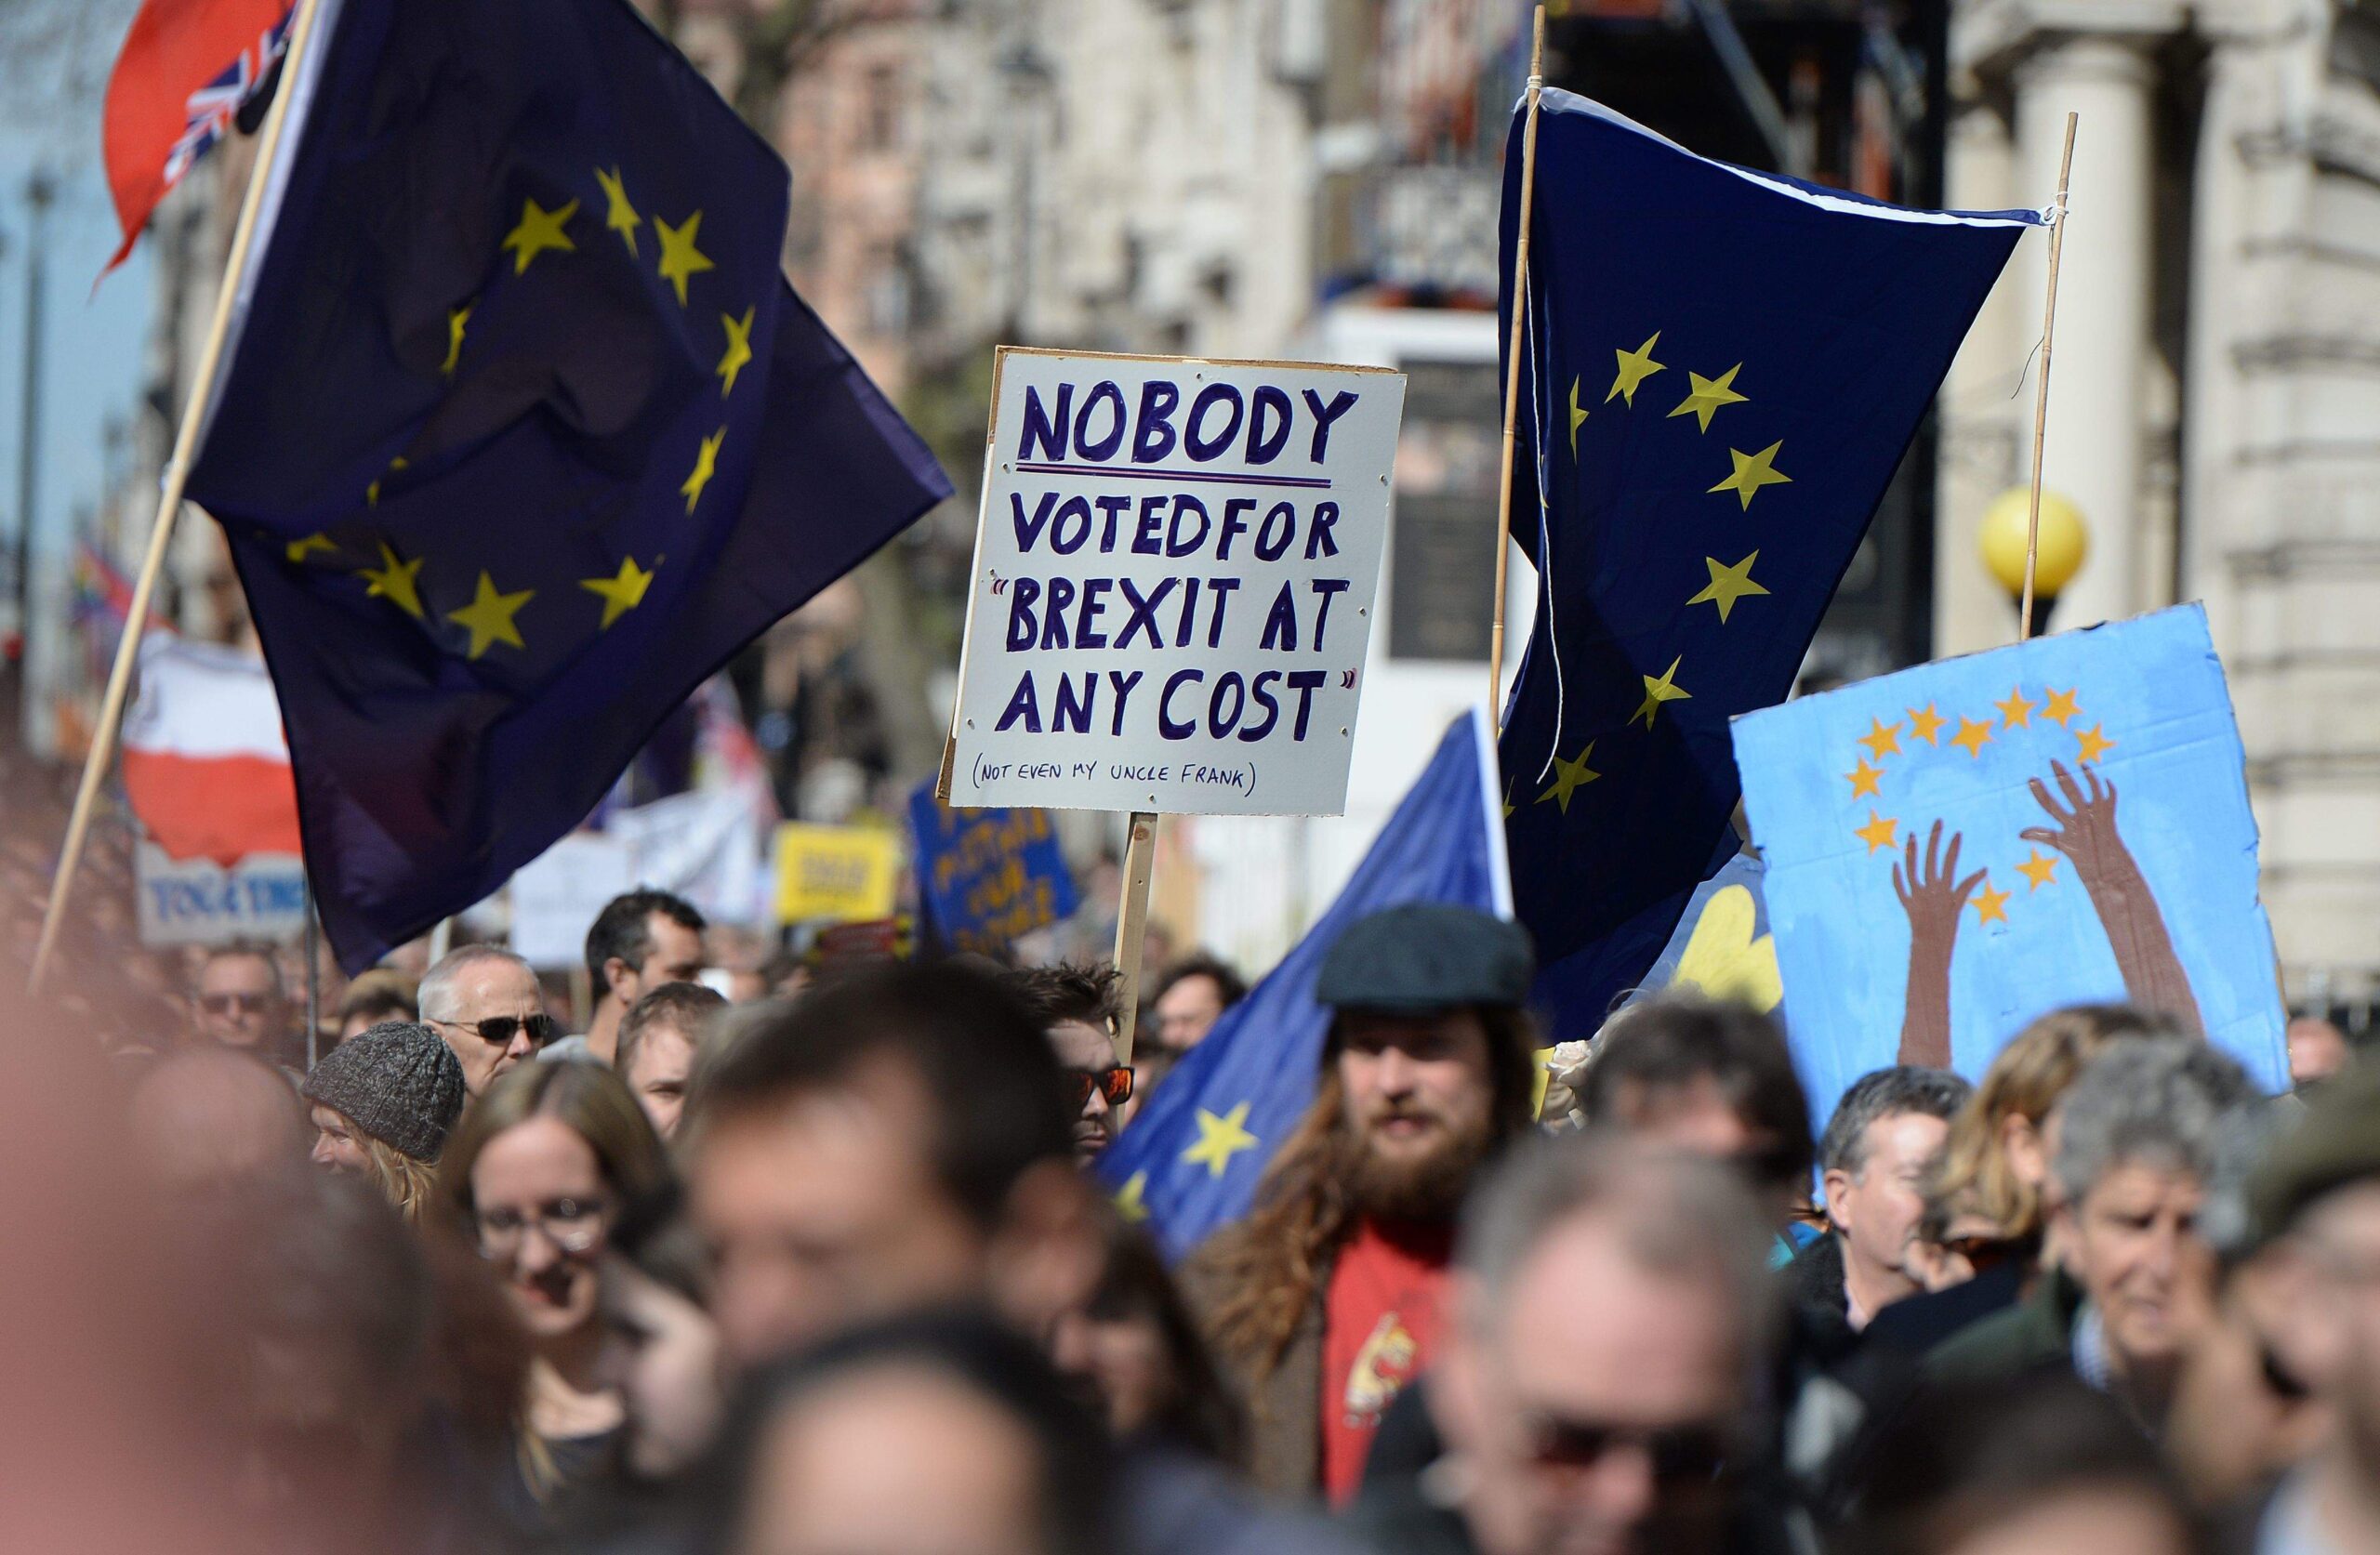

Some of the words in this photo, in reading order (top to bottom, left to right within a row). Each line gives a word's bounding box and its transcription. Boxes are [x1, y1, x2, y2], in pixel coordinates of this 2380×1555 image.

[1015, 379, 1360, 464] NOBODY
[1259, 578, 1351, 652] AT
[994, 669, 1144, 737] ANY
[972, 752, 1012, 789] (NOT
[1017, 763, 1062, 780] EVEN
[1072, 760, 1098, 781] MY
[1110, 764, 1170, 782] UNCLE
[1181, 761, 1256, 798] FRANK)
